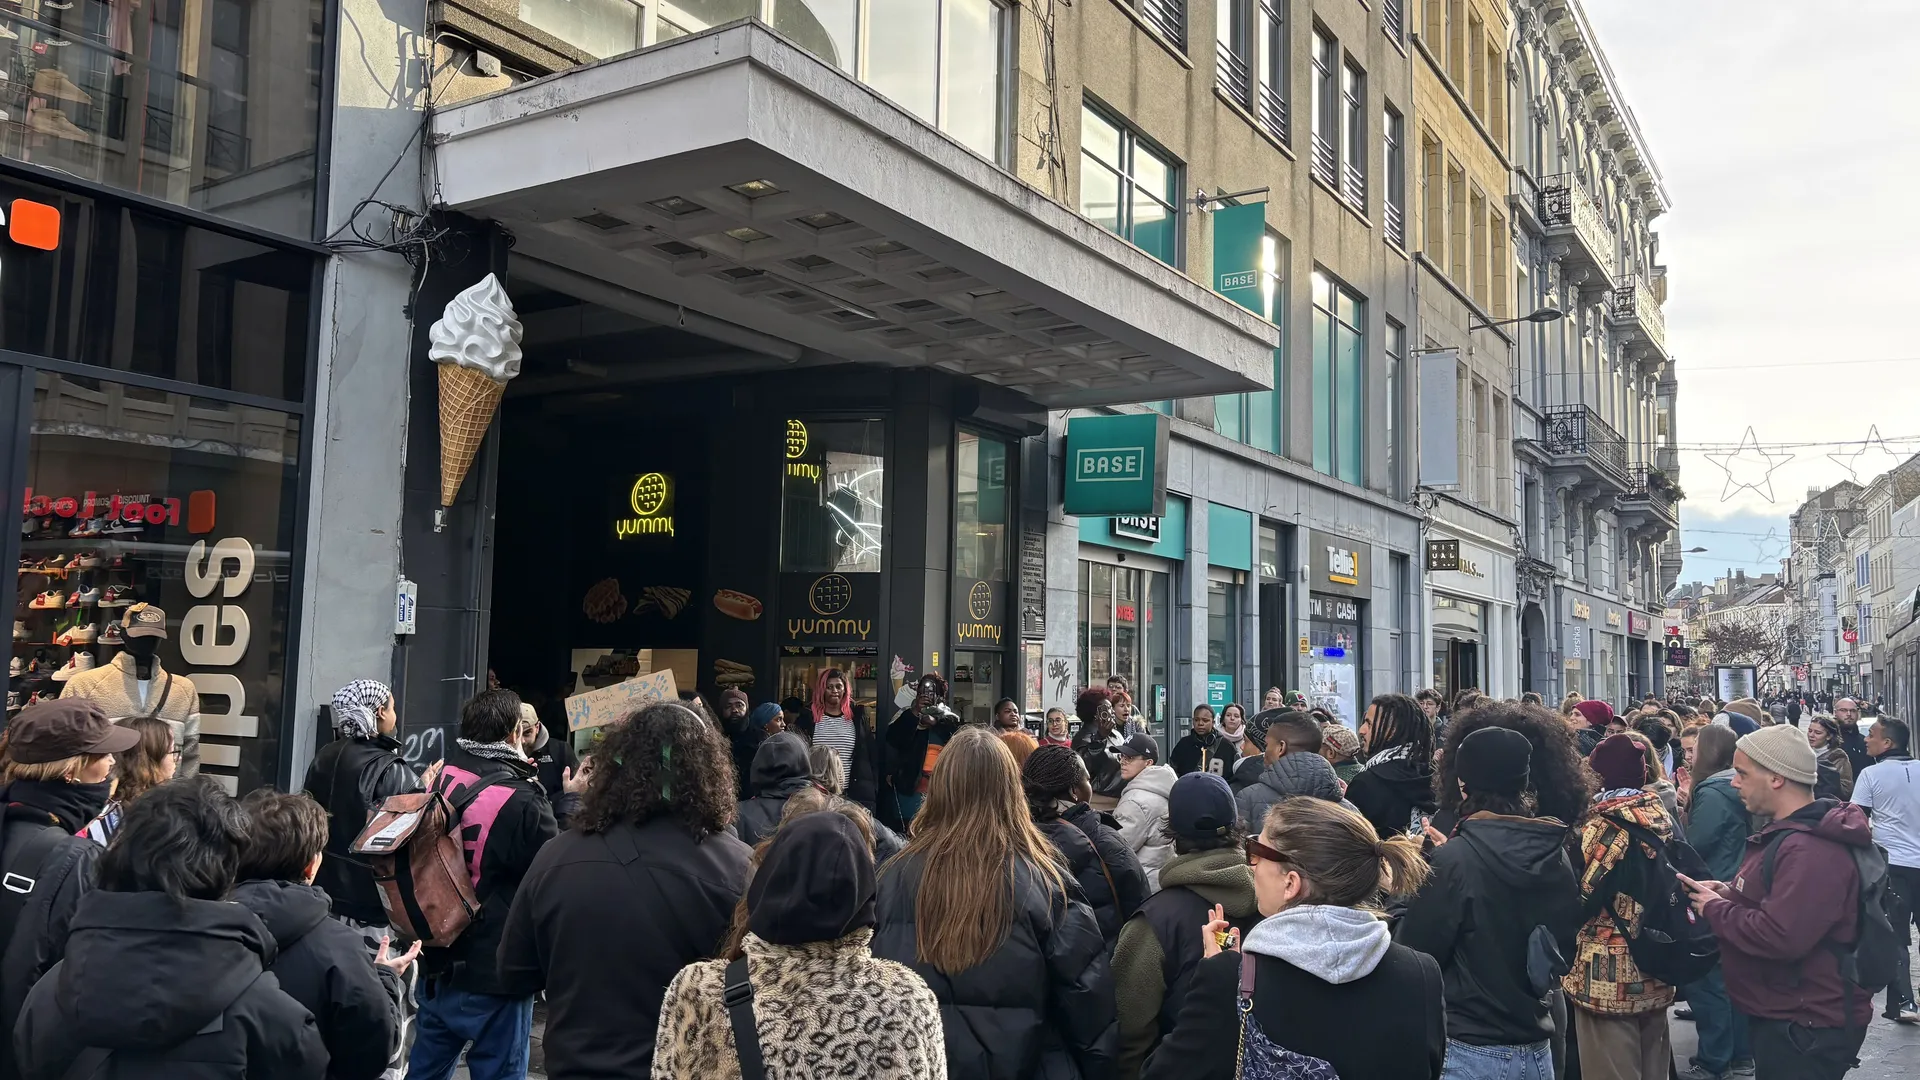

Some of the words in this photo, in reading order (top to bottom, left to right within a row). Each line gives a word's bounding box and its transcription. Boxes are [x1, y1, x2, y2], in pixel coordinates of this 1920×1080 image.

[1224, 274, 1254, 287] BASE
[1083, 455, 1136, 474] BASE
[118, 494, 151, 505] DISCOUNT
[1310, 599, 1322, 616] TM
[1336, 602, 1357, 621] CASH
[788, 618, 871, 640] yummy
[957, 622, 1002, 644] yummy
[1573, 626, 1582, 658] Bershka
